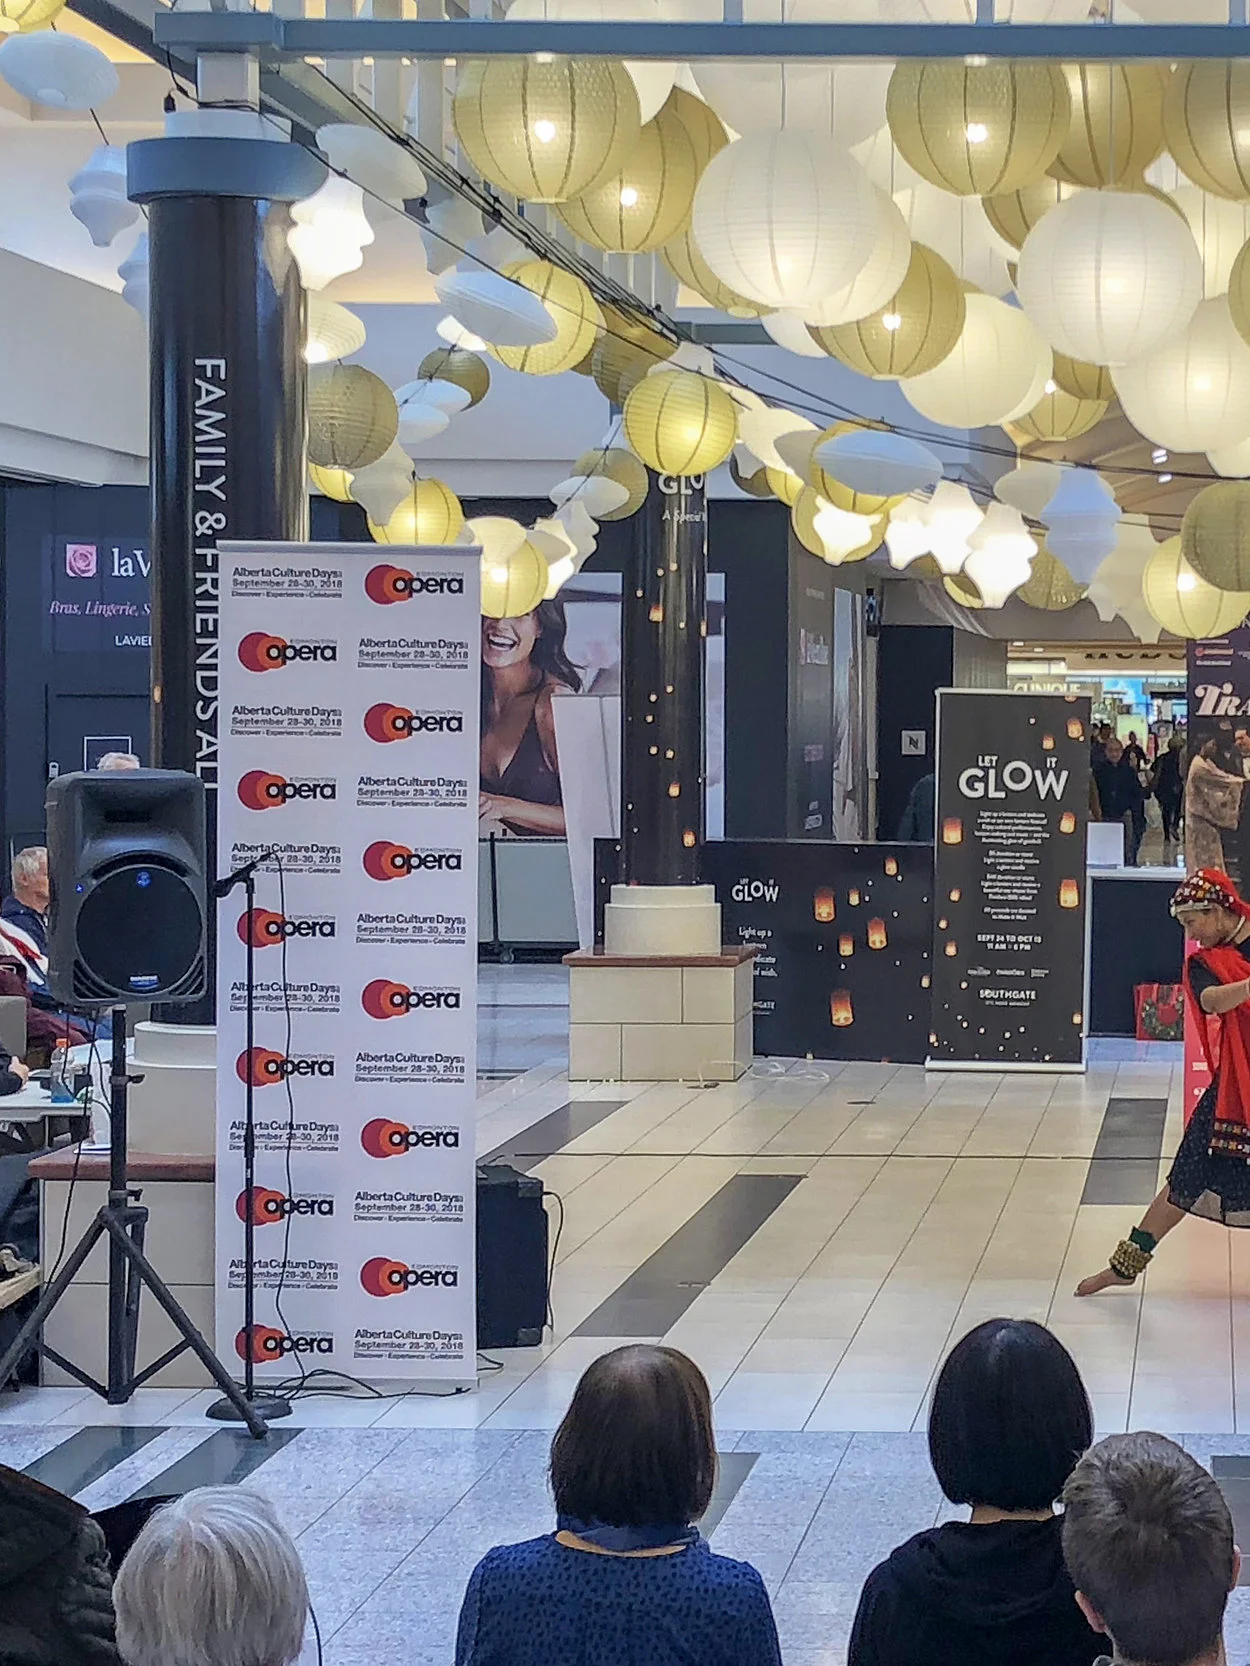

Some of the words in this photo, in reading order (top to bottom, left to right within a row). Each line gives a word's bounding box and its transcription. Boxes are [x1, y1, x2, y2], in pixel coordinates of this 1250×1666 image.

[194, 358, 226, 501] FAMILY
[194, 510, 226, 537] &
[232, 579, 284, 588] September
[393, 576, 463, 597] opera
[50, 600, 81, 616] Bras,
[85, 600, 139, 618] Lingerie,
[194, 548, 219, 721] FRIENDS
[266, 643, 336, 664] opera
[358, 650, 410, 659] September
[232, 717, 284, 726] September
[392, 714, 462, 735] opera
[978, 755, 998, 767] LET
[1046, 757, 1058, 768] IT
[959, 760, 1069, 800] GLOW
[266, 782, 336, 803] opera
[357, 788, 409, 797] September
[391, 852, 461, 873] opera
[732, 881, 779, 902] GLOW
[265, 919, 335, 940] opera
[356, 925, 408, 934] September
[738, 926, 756, 939] Light
[390, 991, 460, 1012] opera
[979, 989, 1036, 1000] SOUTHGATE
[264, 1058, 334, 1079] opera
[355, 1064, 407, 1073] September
[389, 1130, 459, 1151] opera
[264, 1197, 334, 1218] opera
[354, 1203, 406, 1212] September
[388, 1269, 458, 1290] opera
[263, 1335, 333, 1356] opera
[353, 1341, 405, 1350] September
